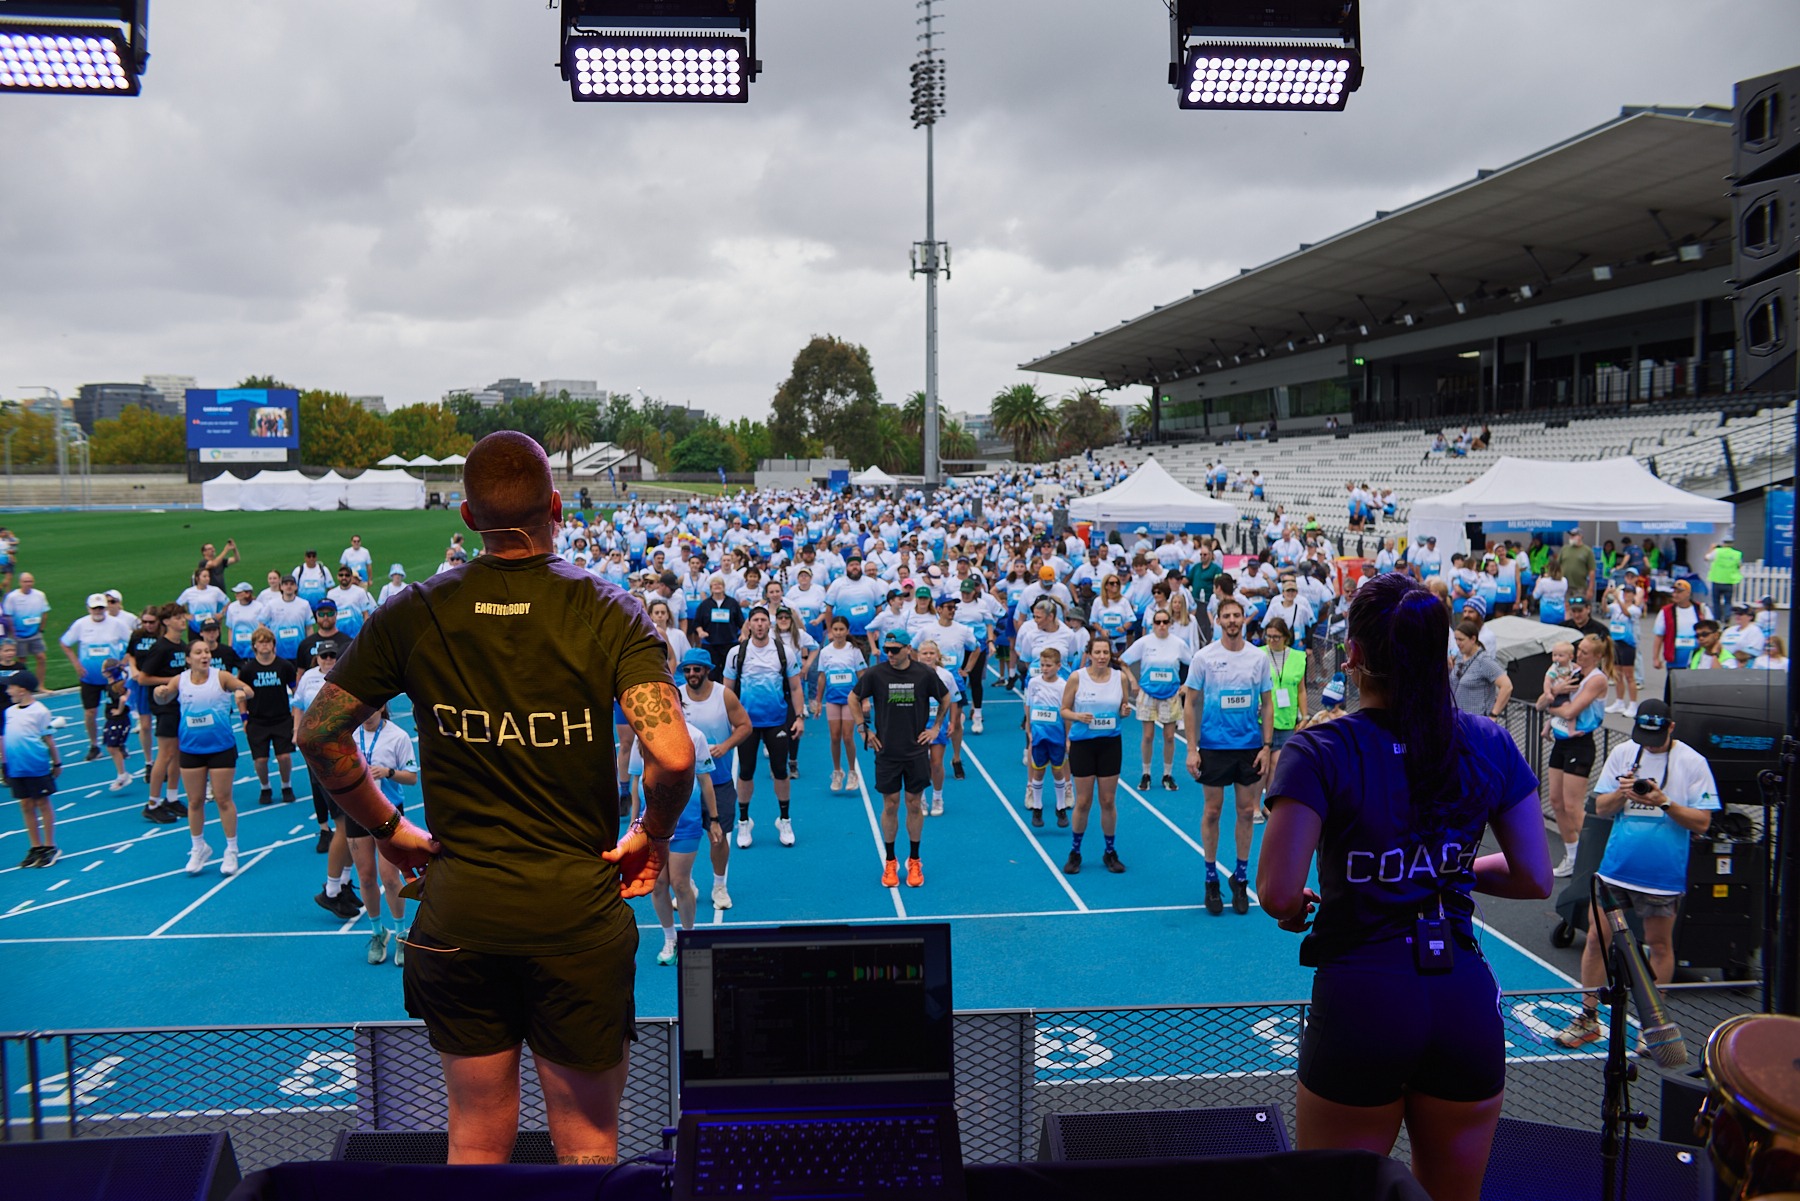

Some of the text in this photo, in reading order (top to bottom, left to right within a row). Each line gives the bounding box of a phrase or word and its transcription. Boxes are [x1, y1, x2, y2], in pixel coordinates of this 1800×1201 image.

[256, 671, 278, 680] TEAM
[1227, 696, 1246, 704] 1585
[432, 703, 594, 748] COACH
[1346, 840, 1481, 883] COACH
[14, 1055, 125, 1107] 4
